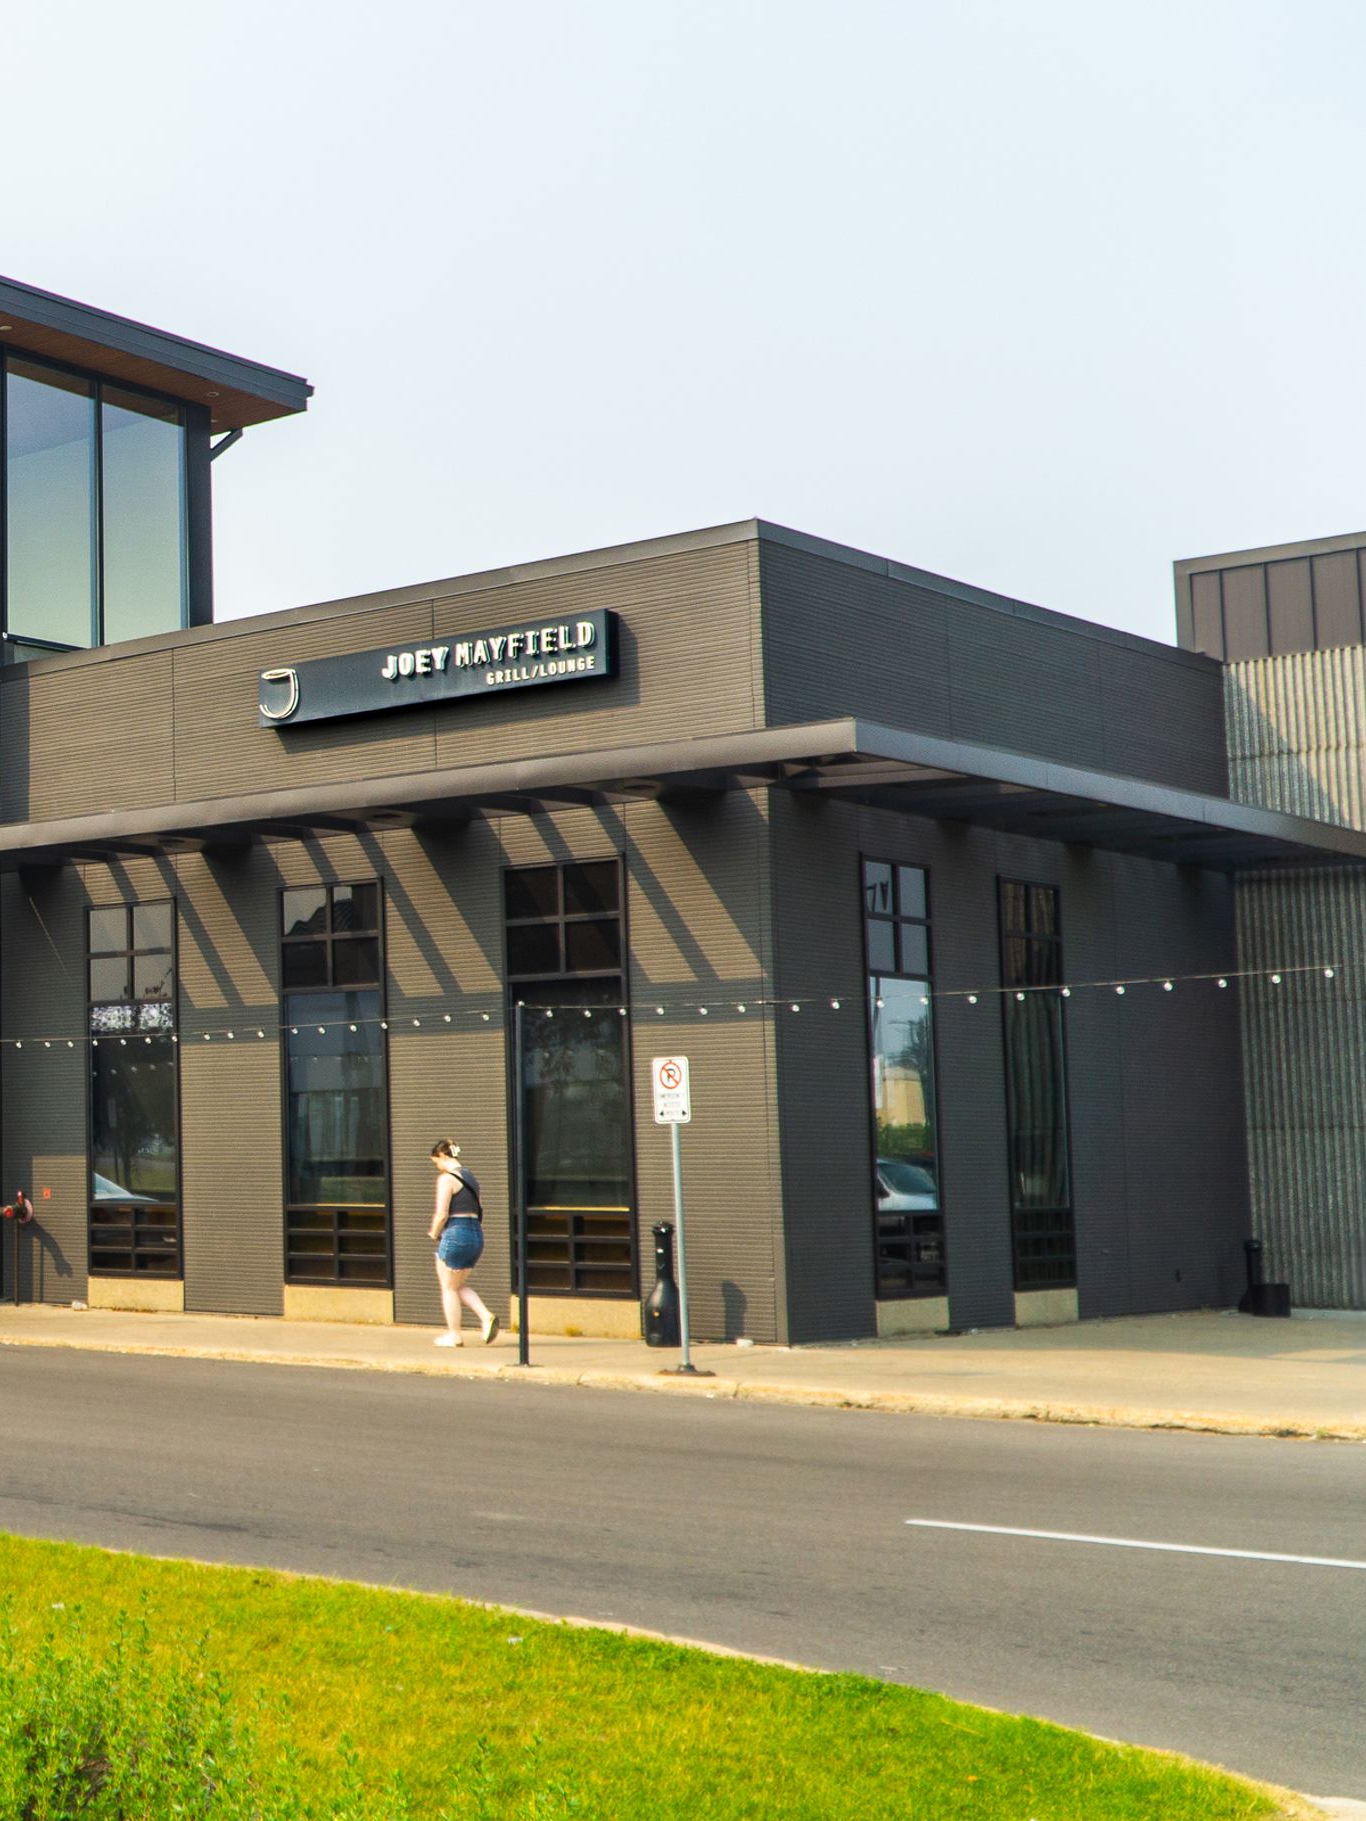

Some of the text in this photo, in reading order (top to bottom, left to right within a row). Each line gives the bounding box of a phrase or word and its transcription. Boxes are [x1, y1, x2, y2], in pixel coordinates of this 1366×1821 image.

[381, 621, 595, 679] JOEY MAYFIELD
[486, 655, 595, 686] GRILL/LOUNGE
